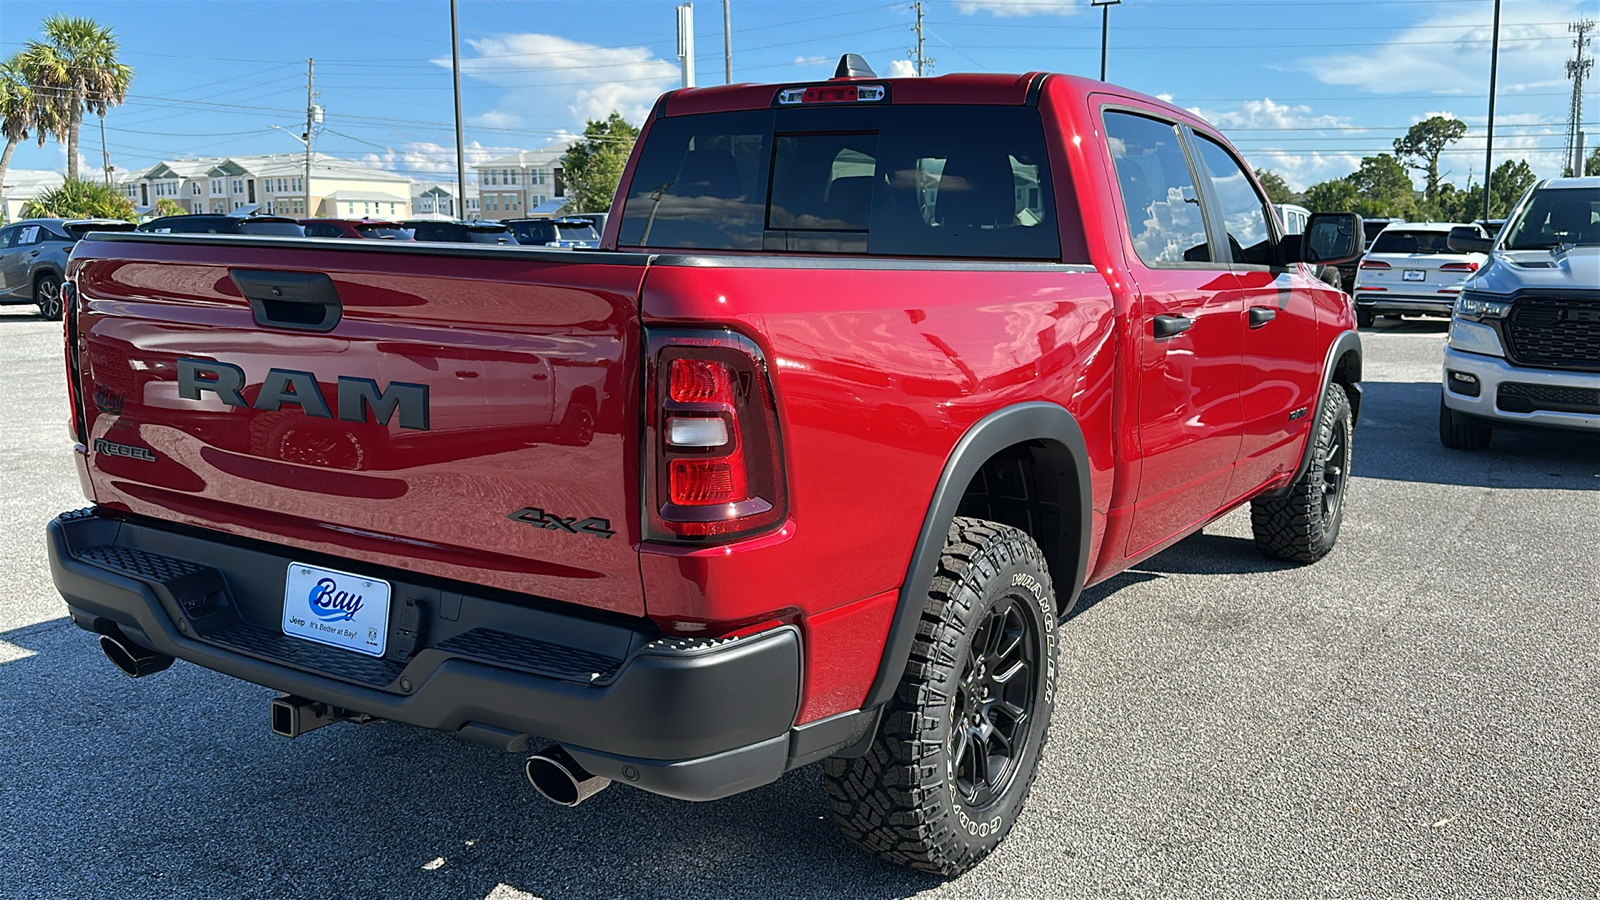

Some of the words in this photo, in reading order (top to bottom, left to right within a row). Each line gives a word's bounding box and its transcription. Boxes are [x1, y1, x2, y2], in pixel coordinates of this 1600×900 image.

[177, 357, 430, 431] RAM
[94, 438, 158, 462] REBEL
[312, 577, 364, 622] Bay
[290, 616, 305, 627] Jeep
[309, 621, 318, 630] It's
[320, 623, 336, 633] Better
[344, 630, 357, 639] Bay!
[1011, 572, 1055, 705] WRANGLER
